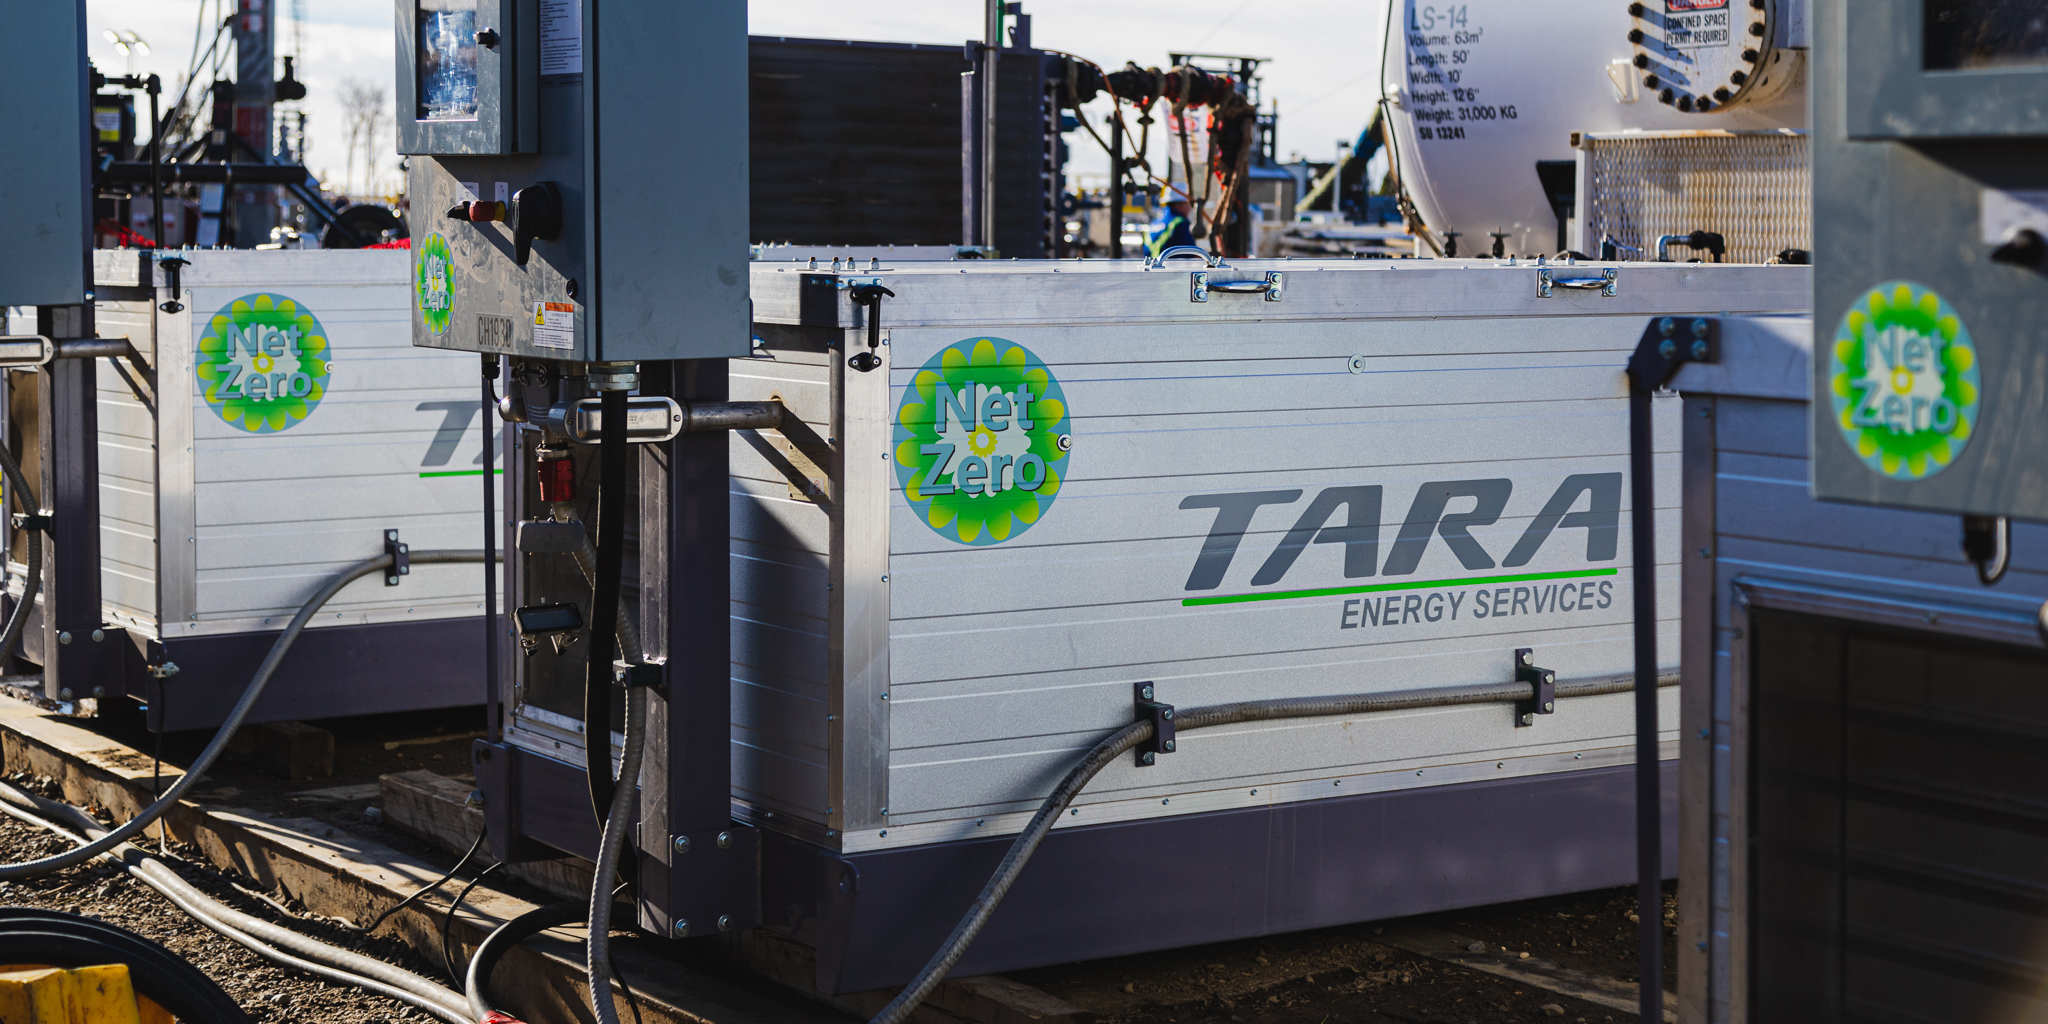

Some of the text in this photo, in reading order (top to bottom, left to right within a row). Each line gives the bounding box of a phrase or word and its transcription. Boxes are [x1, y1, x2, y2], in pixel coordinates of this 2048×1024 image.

[1411, 5, 1468, 31] LS-14
[1667, 13, 1727, 30] CONFINED SPACE
[1408, 34, 1450, 47] Volume:
[1665, 29, 1728, 46] PERMIT REQUIRED
[1408, 51, 1448, 68] Length:
[1410, 71, 1444, 84] Width:
[1411, 90, 1449, 106] Height:
[1414, 105, 1518, 124] Weight: 31,000 KG
[1419, 126, 1466, 140] SU 13241
[424, 253, 448, 280] Net
[421, 283, 451, 311] Zero
[227, 322, 304, 358] Net
[477, 316, 512, 349] CH1930
[1864, 322, 1949, 377] Net
[215, 364, 313, 400] Zero
[935, 381, 1035, 433] Net
[1851, 377, 1960, 435] Zero
[919, 443, 1047, 496] Zero
[1178, 471, 1623, 592] TARA
[1340, 580, 1614, 630] ENERGY SERVICES
